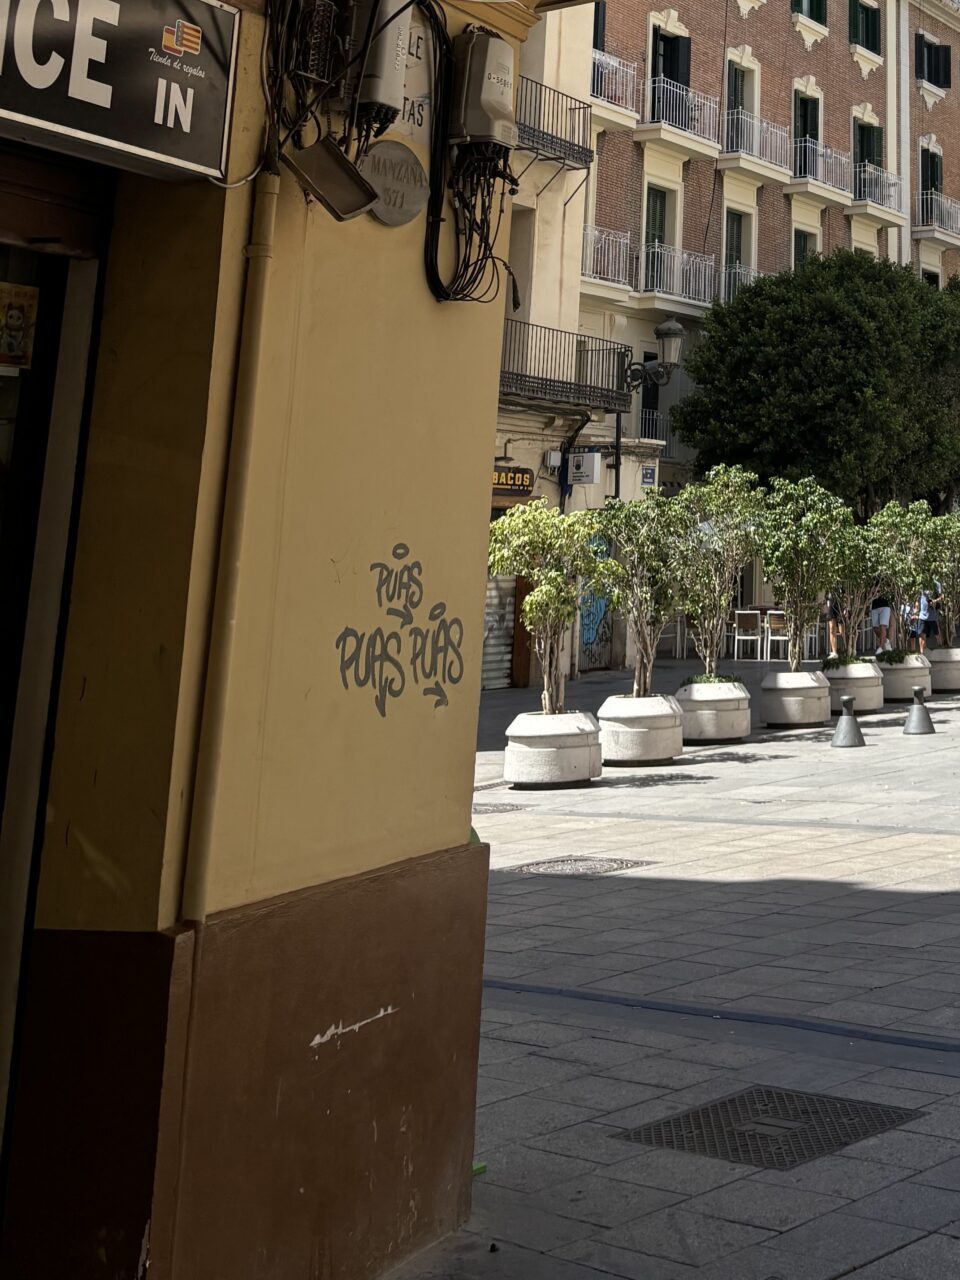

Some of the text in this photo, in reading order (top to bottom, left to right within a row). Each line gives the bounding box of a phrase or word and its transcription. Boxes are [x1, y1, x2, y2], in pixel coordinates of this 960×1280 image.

[148, 48, 205, 78] Tienda de regalos
[154, 77, 194, 133] IN
[371, 154, 424, 188] MANZANA
